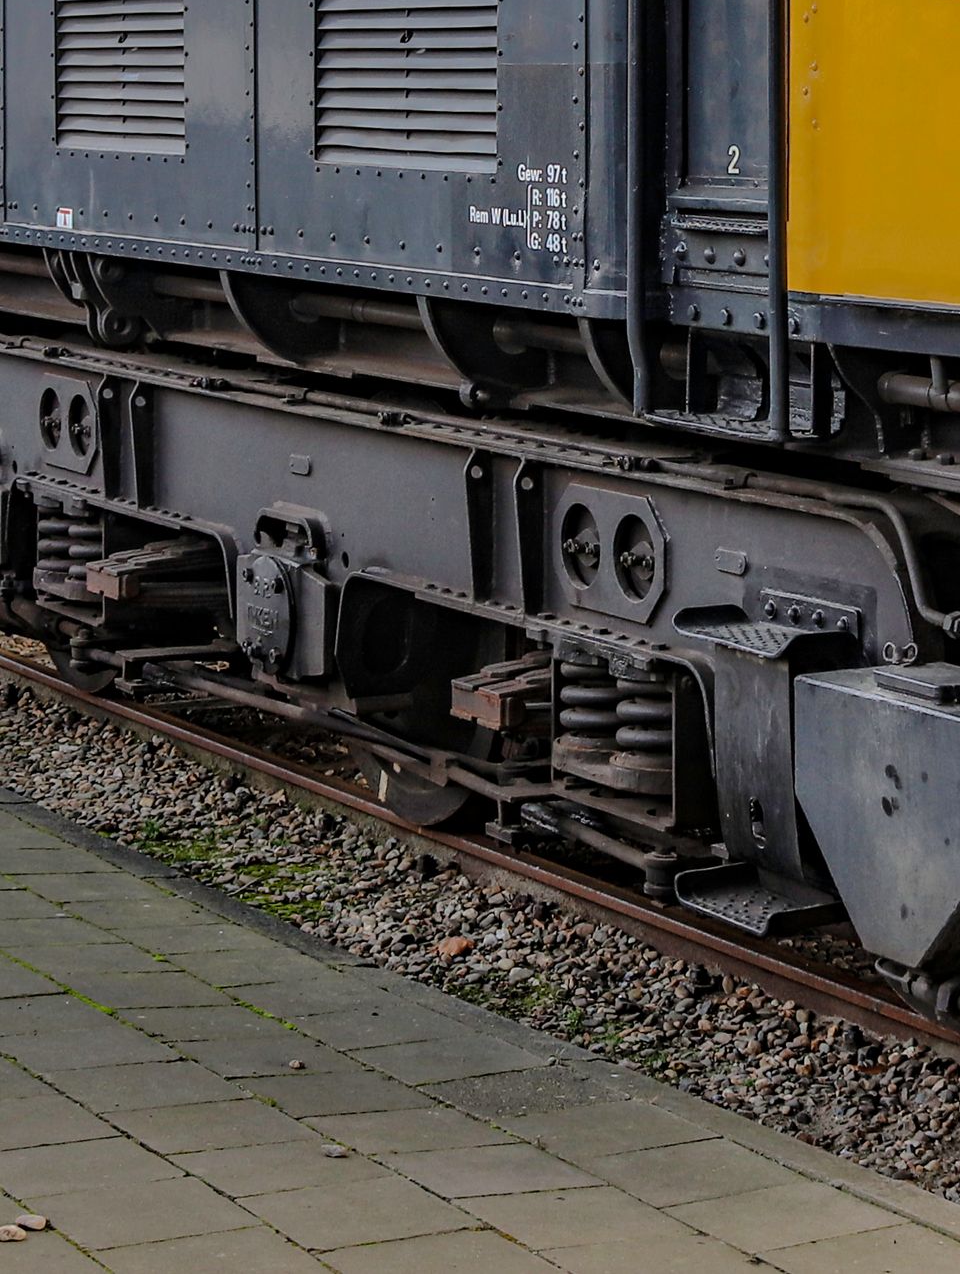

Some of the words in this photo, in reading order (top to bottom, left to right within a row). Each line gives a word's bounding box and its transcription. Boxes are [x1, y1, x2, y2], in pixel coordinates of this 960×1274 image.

[728, 146, 739, 174] 2
[518, 164, 543, 182] Gew:
[547, 164, 560, 183] 97
[562, 168, 567, 184] t
[532, 188, 542, 206] R:
[546, 188, 560, 207] 116
[561, 192, 567, 208] t
[469, 206, 489, 224] Rem
[491, 207, 501, 225] W
[532, 211, 542, 228] P:
[546, 211, 560, 230] 78
[561, 214, 567, 231] t
[531, 232, 541, 250] G:
[546, 233, 560, 253] 48
[562, 237, 567, 254] t
